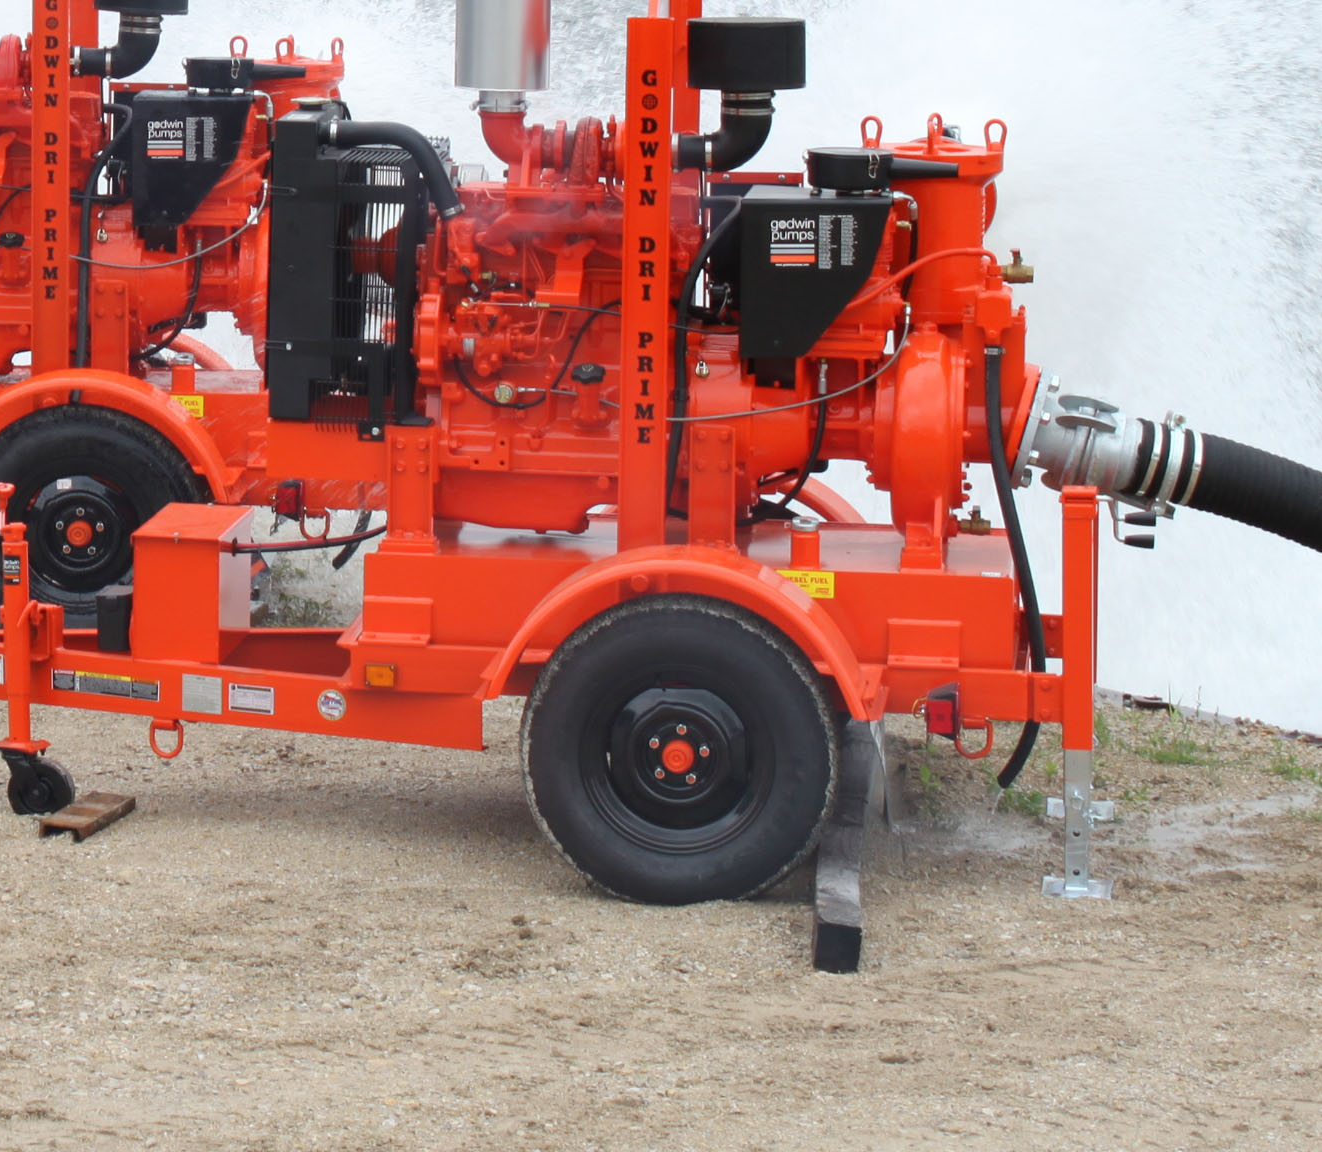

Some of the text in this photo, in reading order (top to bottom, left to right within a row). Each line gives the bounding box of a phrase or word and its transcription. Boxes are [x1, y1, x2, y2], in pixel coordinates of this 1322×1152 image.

[147, 119, 183, 130] godwin
[148, 129, 183, 139] pumps
[44, 132, 58, 184] DRI
[770, 218, 815, 232] godwin
[771, 231, 815, 242] pumps
[42, 209, 58, 299] PRIME
[638, 237, 656, 301] DRI
[635, 332, 654, 444] PRIME
[810, 577, 829, 585] FUEL
